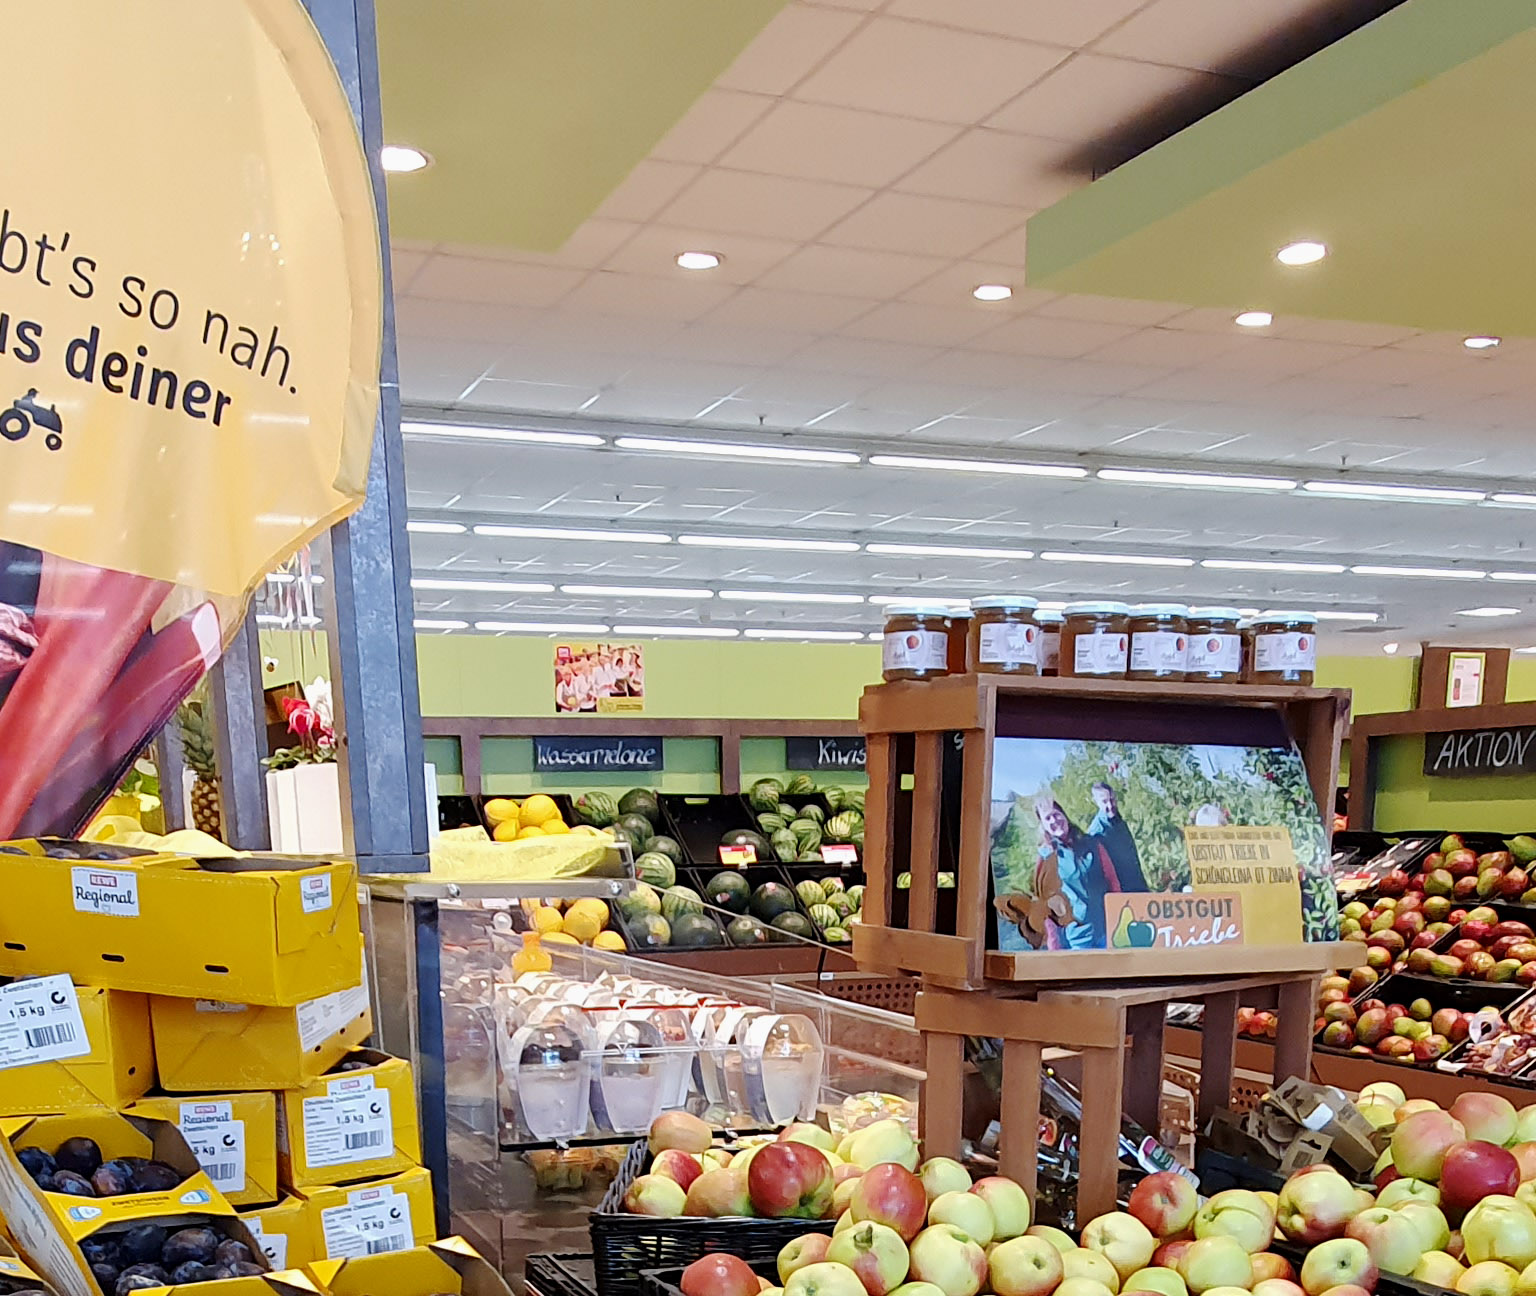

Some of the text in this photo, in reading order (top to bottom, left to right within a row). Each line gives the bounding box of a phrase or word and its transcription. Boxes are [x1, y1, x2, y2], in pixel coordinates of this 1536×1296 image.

[120, 274, 179, 332] so
[202, 308, 299, 395] nah.
[65, 326, 233, 427] deiner
[1434, 728, 1536, 770] AKTION
[76, 885, 136, 906] Regional
[1147, 899, 1233, 920] OBSTGUT
[9, 1003, 46, 1019] 1,5 kg
[371, 1219, 384, 1230] kg
